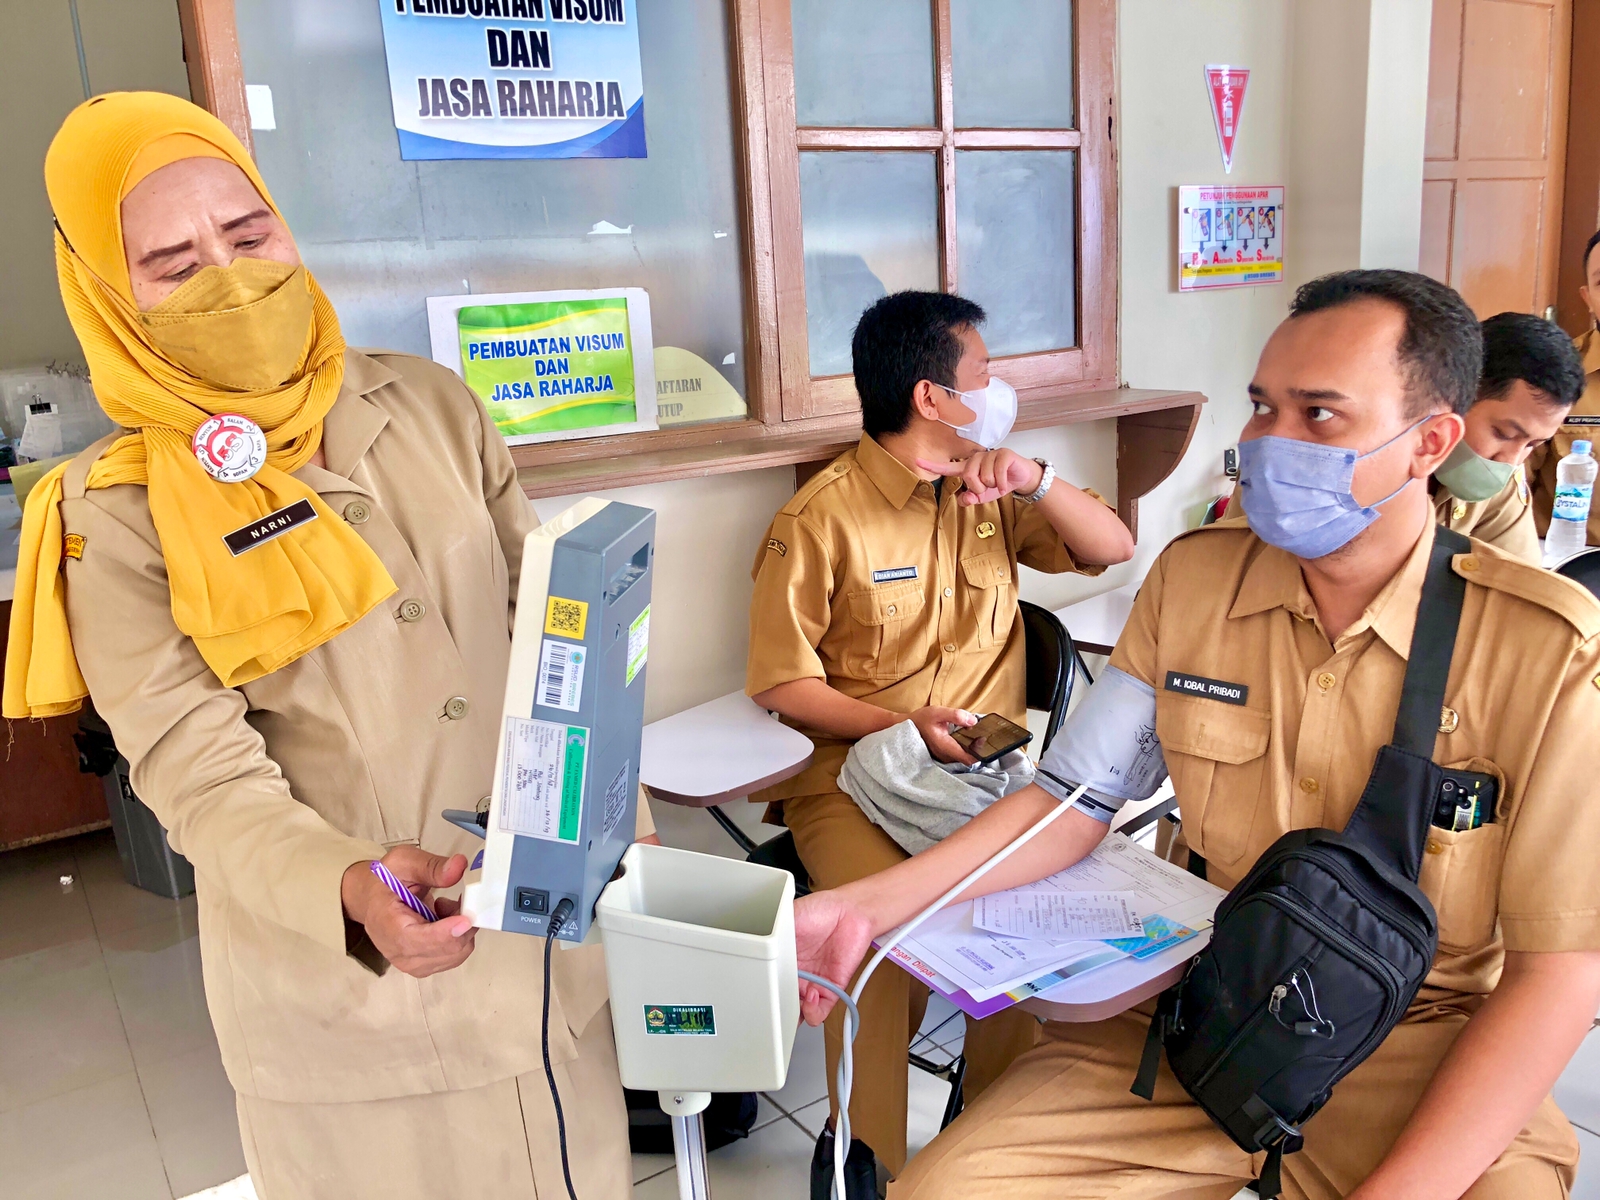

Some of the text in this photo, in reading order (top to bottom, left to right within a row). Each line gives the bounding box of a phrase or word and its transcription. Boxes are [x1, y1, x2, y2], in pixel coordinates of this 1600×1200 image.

[486, 28, 551, 68] DAN
[418, 78, 625, 118] JASA RAHARJA
[469, 333, 624, 360] PEMBUATAN VISUM
[535, 358, 569, 376] DAN
[492, 375, 613, 401] JASA RAHARJA
[250, 514, 292, 539] NARNI
[1173, 678, 1240, 699] M. IQBAL PRIBADI
[521, 916, 542, 924] POWER
[912, 960, 936, 978] Dilipat
